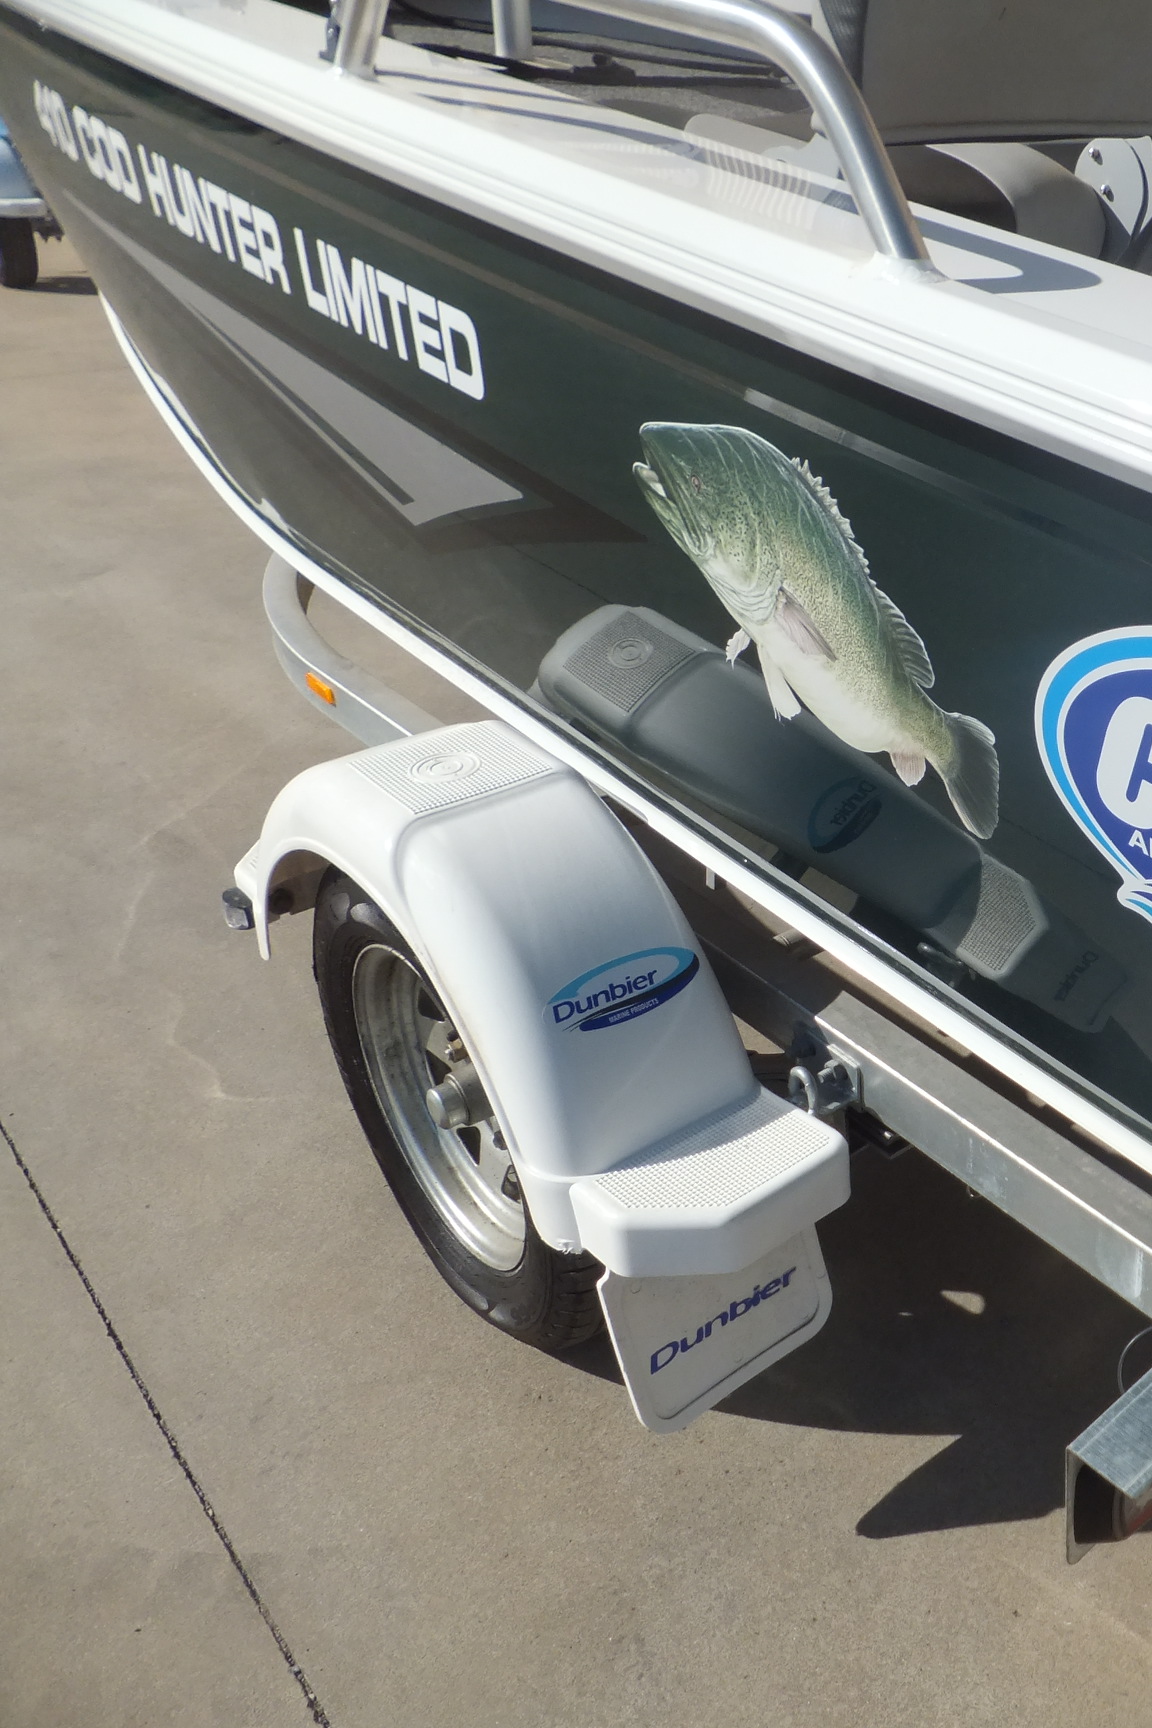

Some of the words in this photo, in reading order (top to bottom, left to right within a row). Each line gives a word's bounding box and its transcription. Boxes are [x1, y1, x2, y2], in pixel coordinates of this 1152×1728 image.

[33, 79, 80, 162] 410
[72, 105, 142, 204] COD
[137, 143, 292, 294] HUNTER
[293, 227, 485, 400] LIMITED
[552, 970, 658, 1023] Dunbier
[608, 1010, 631, 1022] MARINE
[631, 997, 659, 1015] PRODUCTS
[650, 1266, 797, 1375] Dunbier
